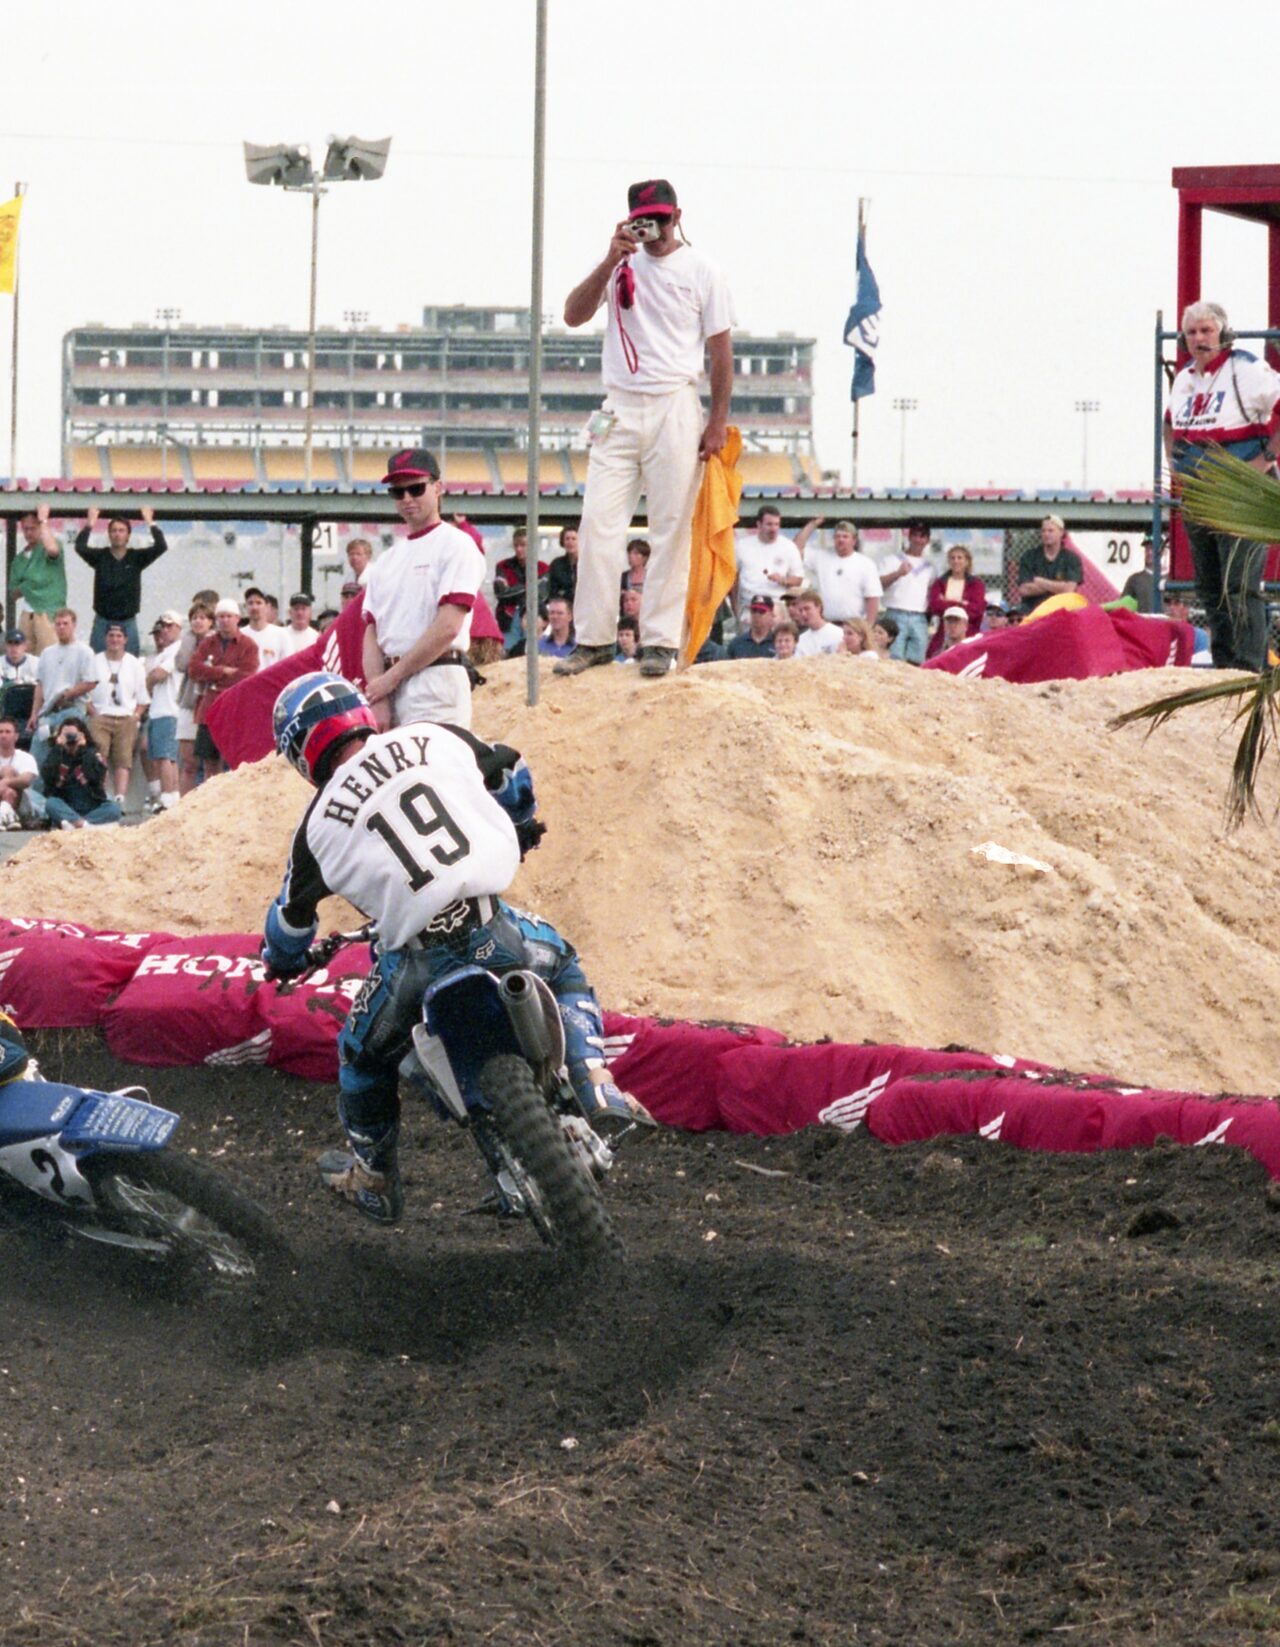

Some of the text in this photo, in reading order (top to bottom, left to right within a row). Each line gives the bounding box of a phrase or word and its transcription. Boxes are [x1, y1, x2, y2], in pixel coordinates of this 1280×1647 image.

[312, 525, 332, 549] 21
[1107, 540, 1130, 564] 20
[323, 735, 431, 829] HENRY
[365, 782, 471, 893] 19
[30, 1148, 86, 1207] 2
